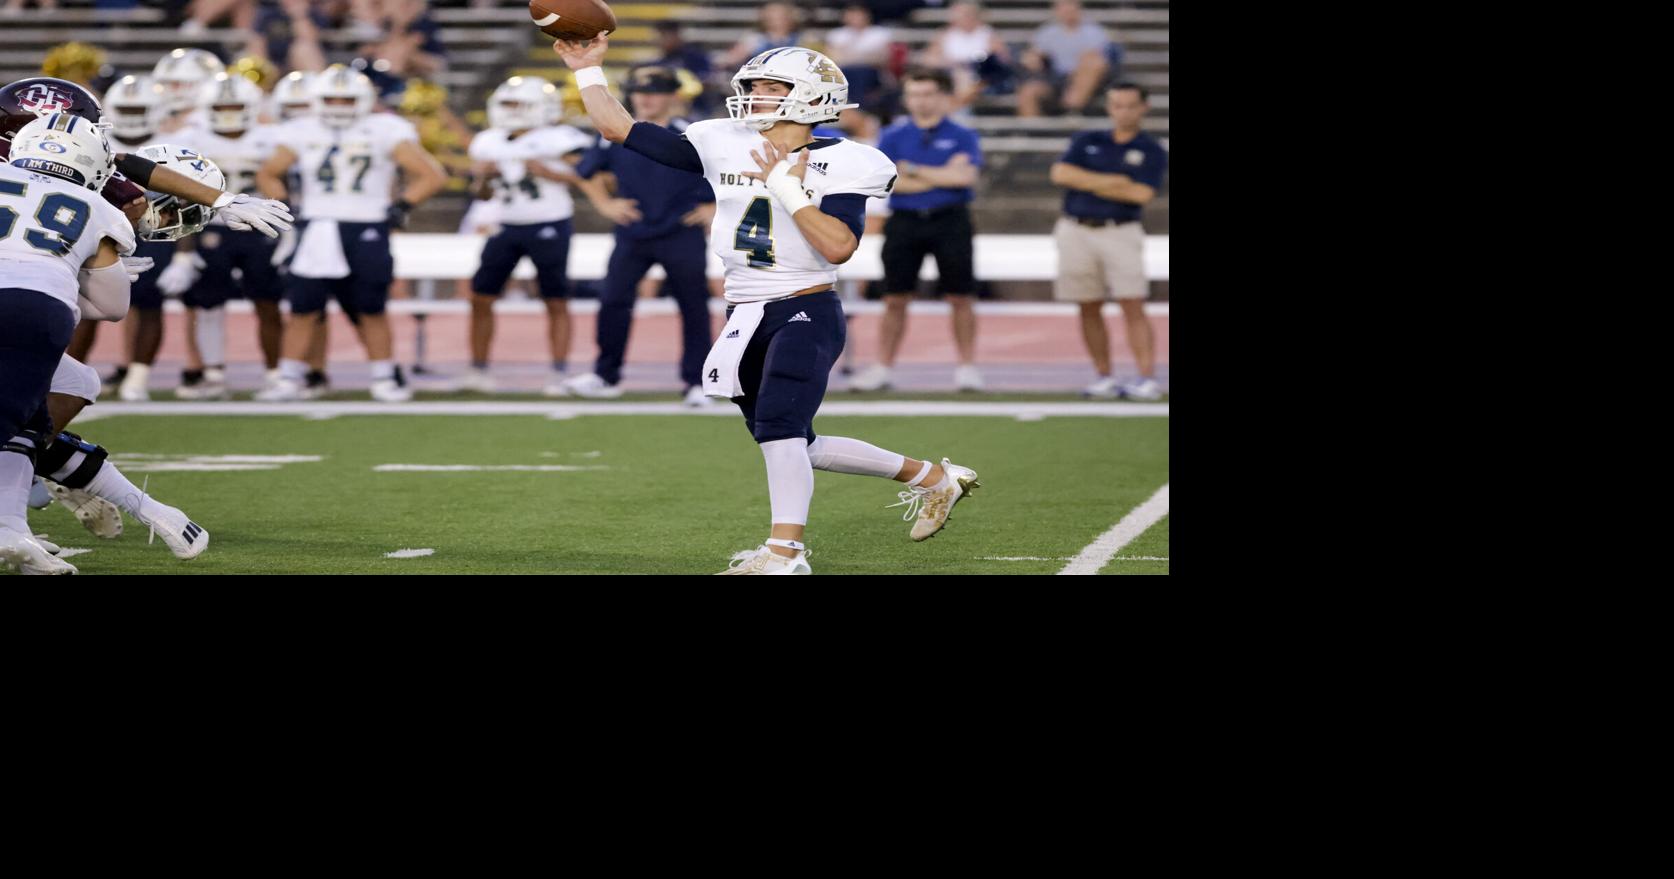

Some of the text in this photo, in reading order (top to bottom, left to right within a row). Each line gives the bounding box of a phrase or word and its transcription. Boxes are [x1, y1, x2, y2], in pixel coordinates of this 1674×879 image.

[28, 159, 42, 169] AM
[46, 161, 74, 176] THIRD
[317, 144, 372, 192] 47
[720, 172, 754, 186] HOLY
[733, 195, 776, 269] 4
[708, 368, 719, 383] 4
